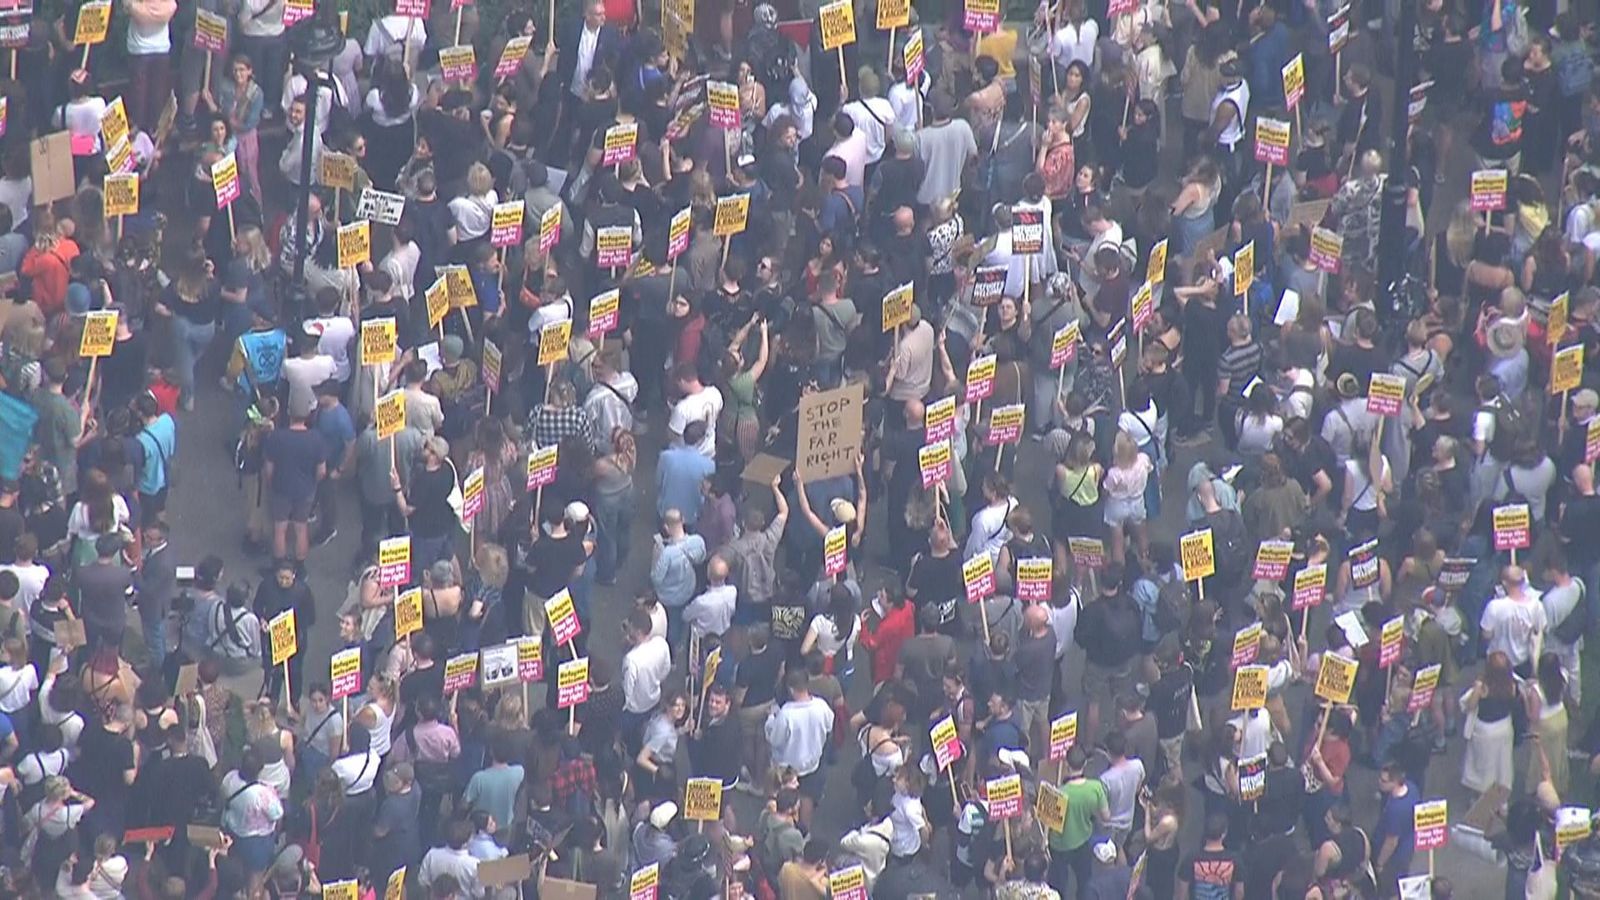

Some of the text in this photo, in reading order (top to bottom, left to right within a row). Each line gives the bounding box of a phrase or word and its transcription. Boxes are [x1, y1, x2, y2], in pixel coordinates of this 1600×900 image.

[806, 397, 850, 421] STOP
[811, 417, 840, 431] THE
[809, 432, 837, 450] FAR
[806, 446, 855, 467] RIGHT
